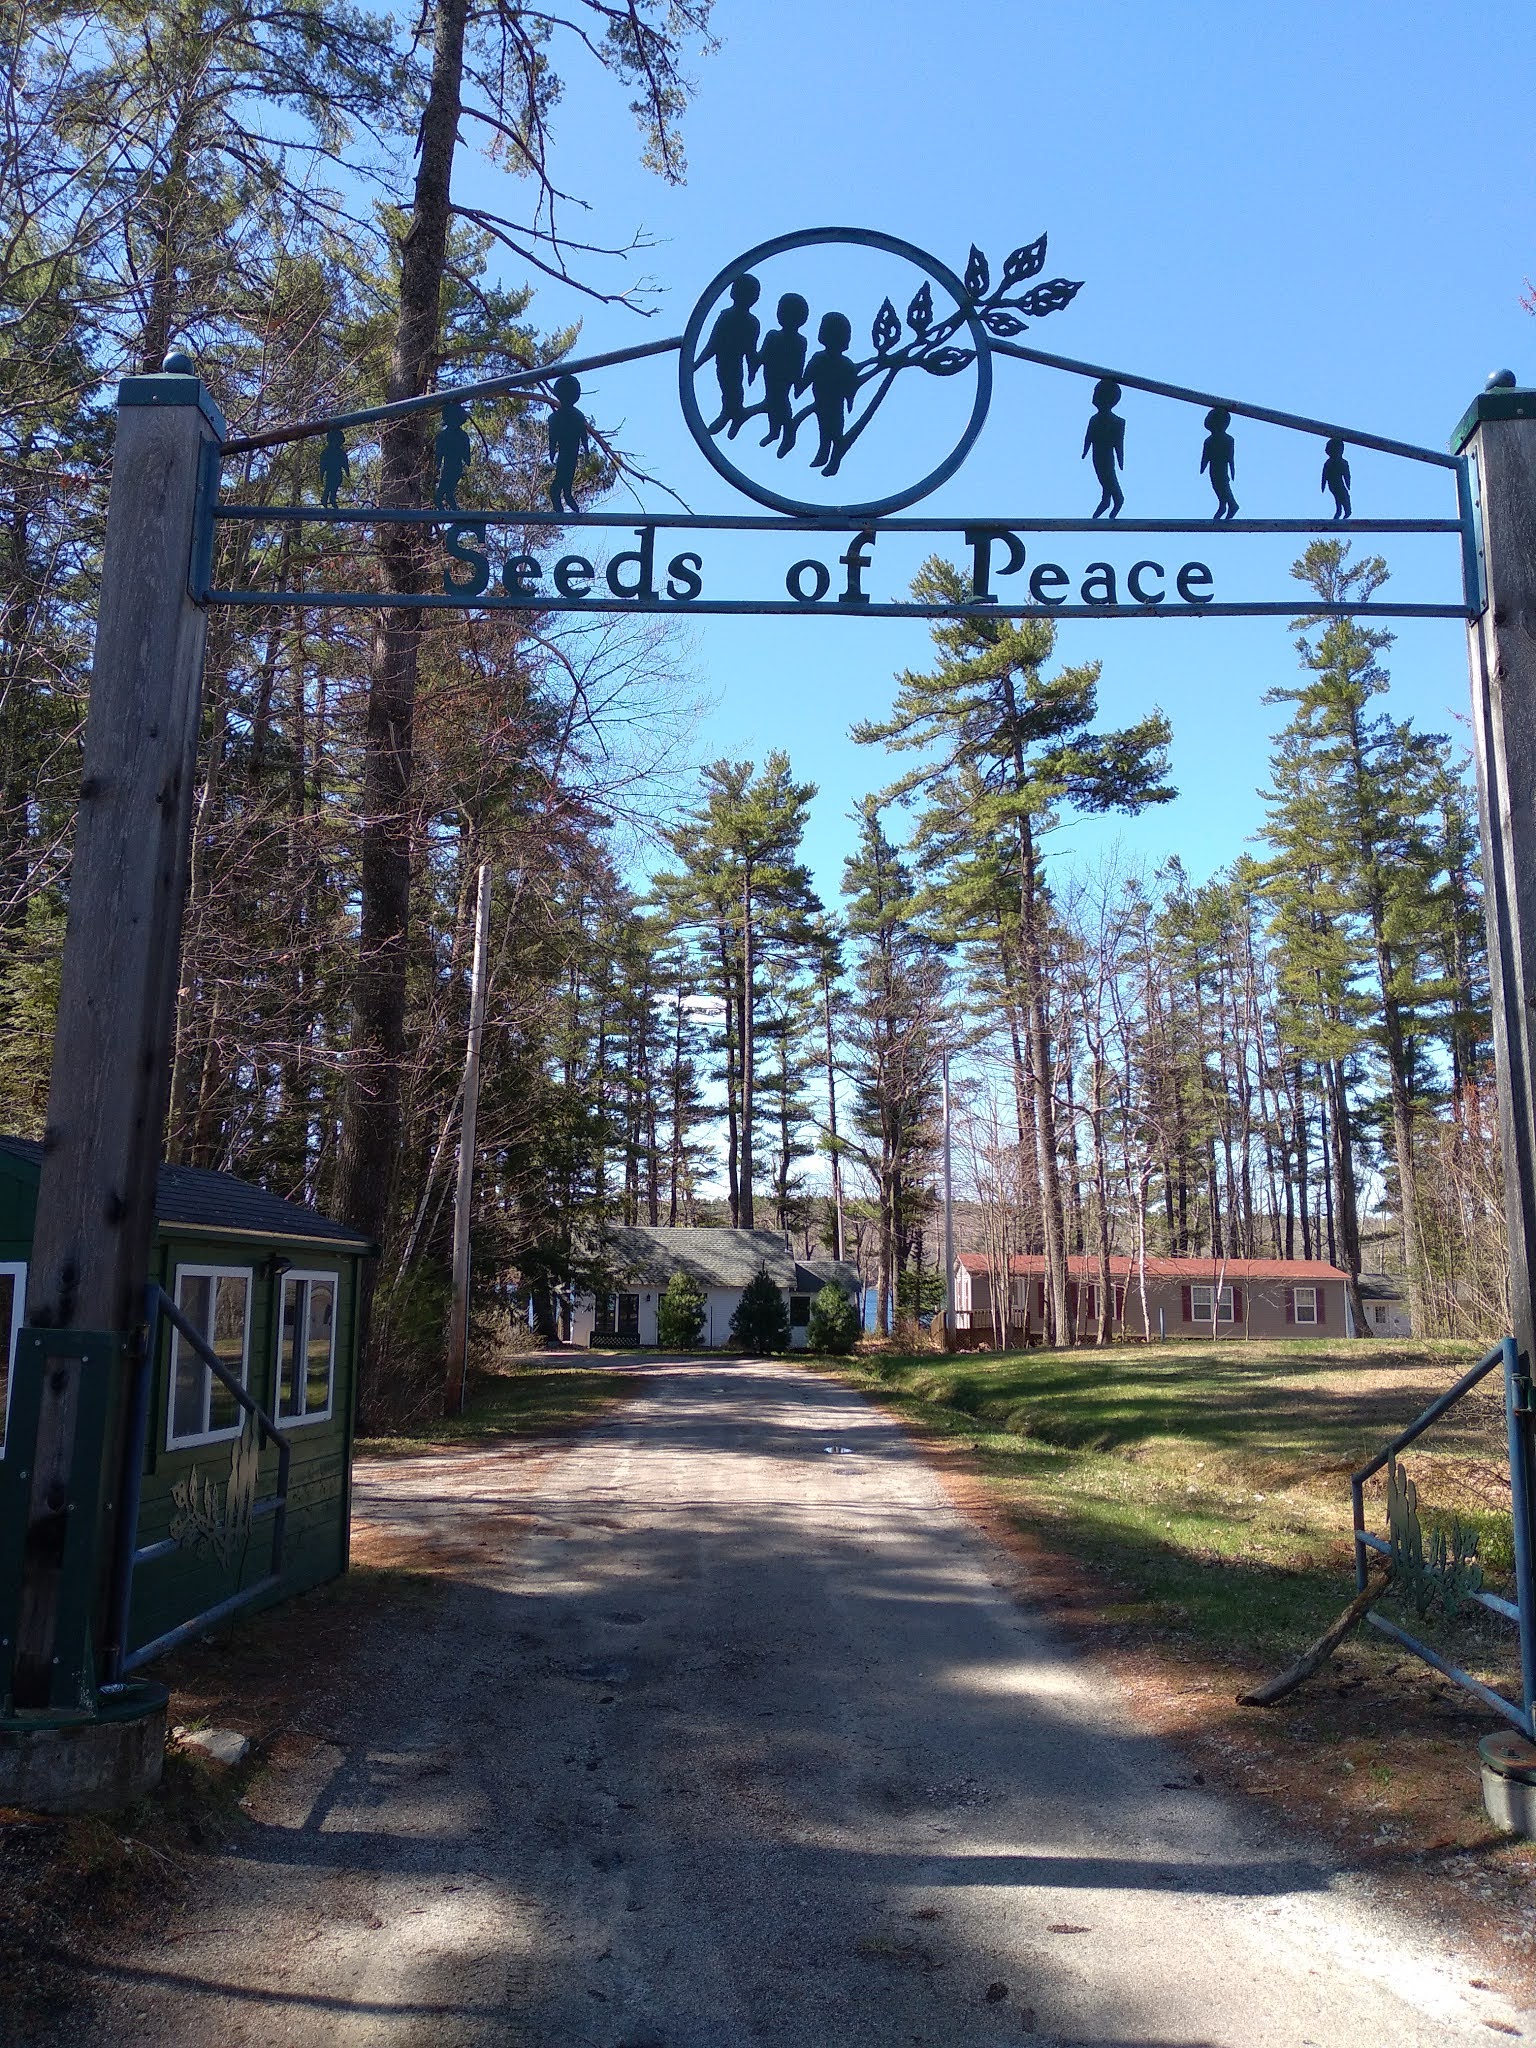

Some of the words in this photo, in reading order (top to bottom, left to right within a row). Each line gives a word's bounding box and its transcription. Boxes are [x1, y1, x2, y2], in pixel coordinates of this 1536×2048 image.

[444, 523, 703, 602] Seeds
[786, 530, 876, 603] of
[965, 529, 1213, 605] Peace
